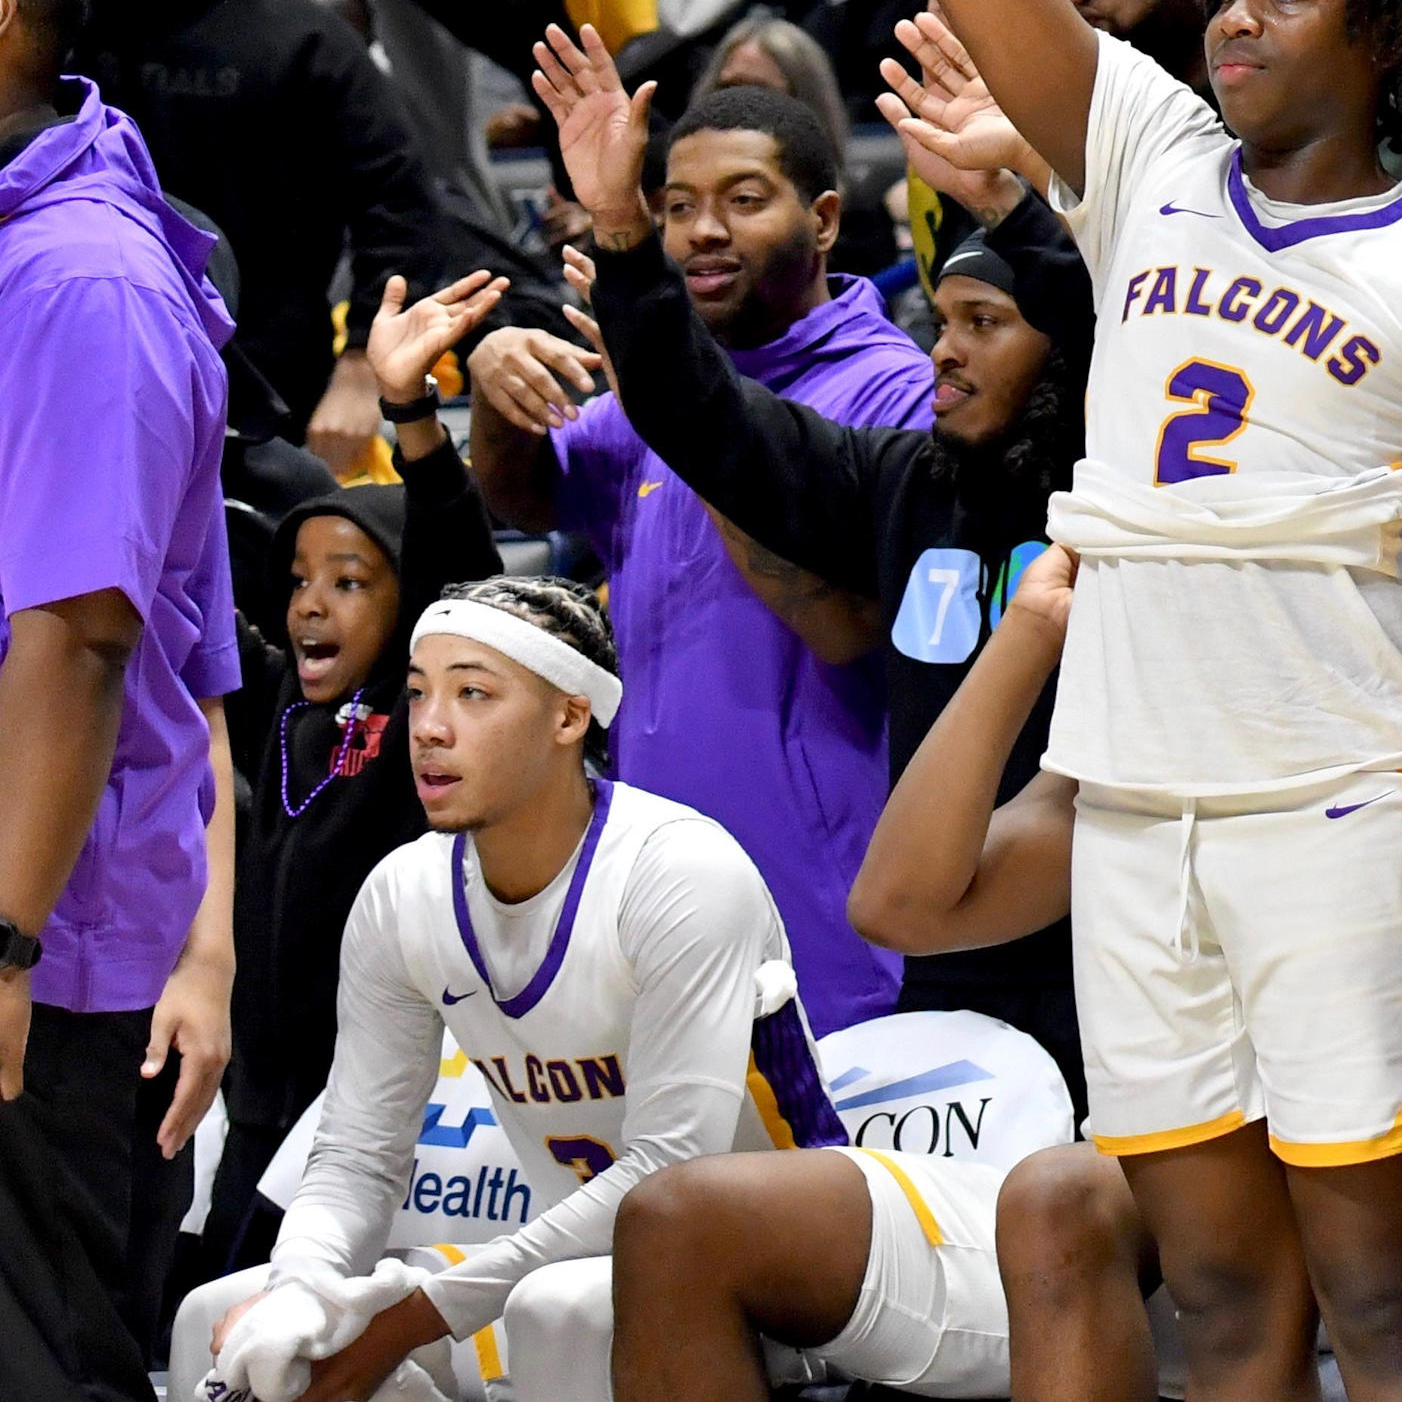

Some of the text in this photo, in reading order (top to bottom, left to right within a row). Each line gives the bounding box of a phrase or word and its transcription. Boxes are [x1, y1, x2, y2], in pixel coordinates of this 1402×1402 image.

[1121, 266, 1383, 388] FALCONS
[1153, 356, 1256, 488] 2
[928, 568, 960, 646] 7
[402, 1158, 532, 1224] ealth
